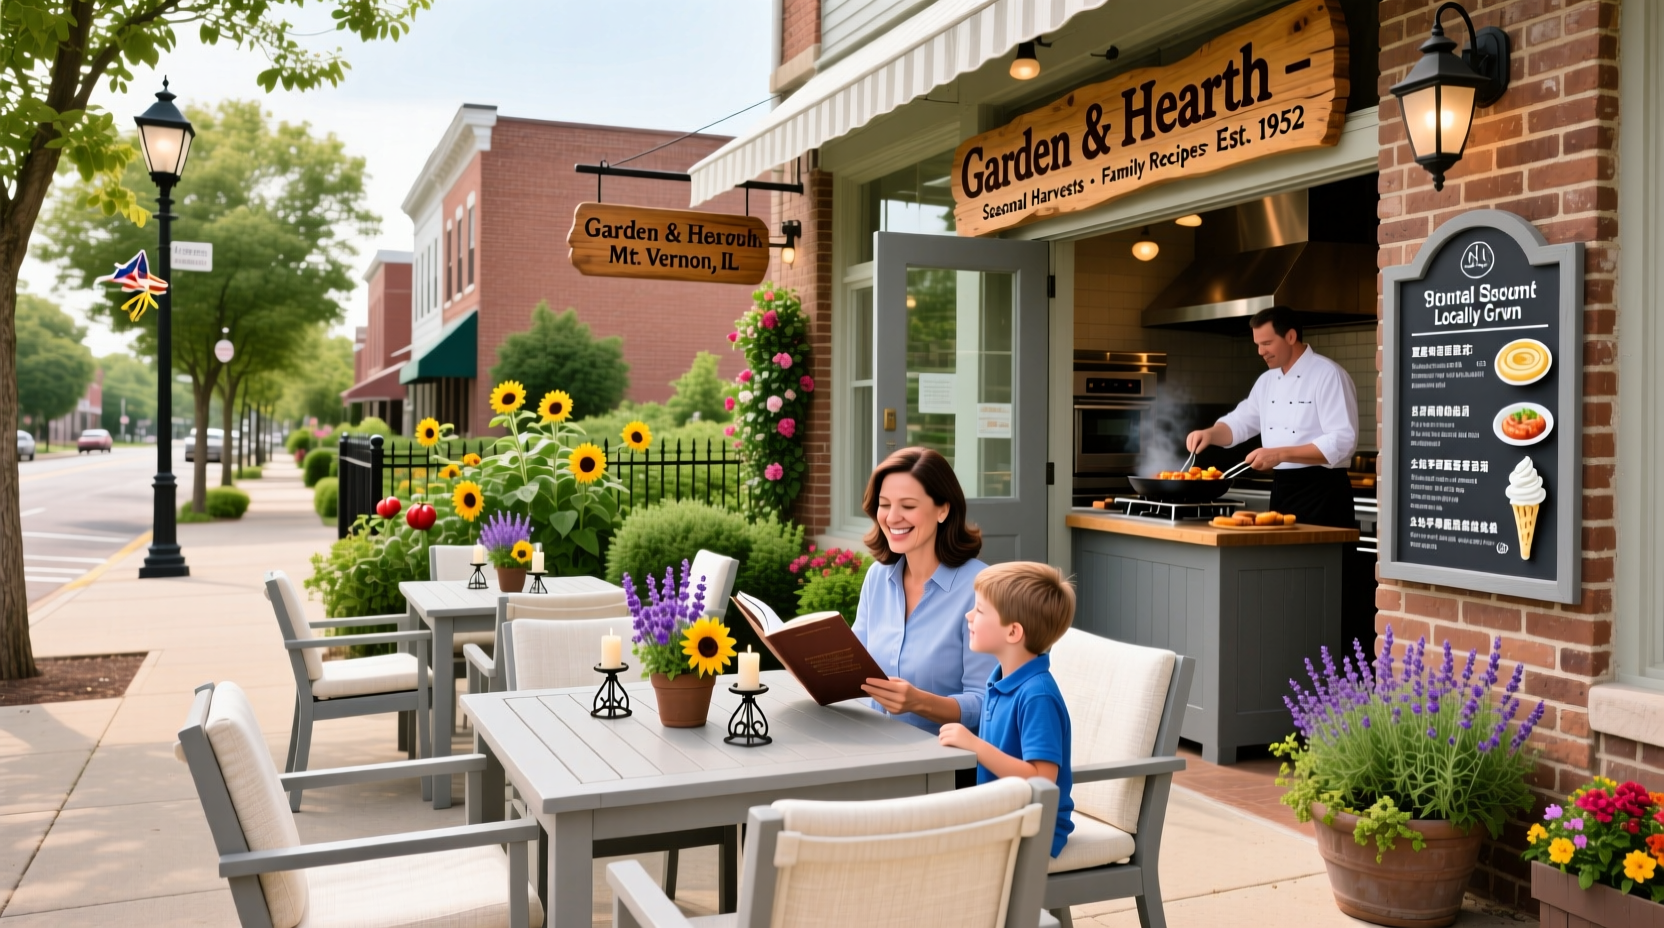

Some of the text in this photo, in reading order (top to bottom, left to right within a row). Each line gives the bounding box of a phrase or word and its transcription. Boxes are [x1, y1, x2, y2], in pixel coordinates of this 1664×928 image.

[961, 126, 1072, 199] Garden
[1082, 103, 1112, 160] &
[1121, 41, 1273, 148] Hearth
[1031, 178, 1085, 207] Harvests
[1102, 158, 1146, 185] Family
[1216, 125, 1252, 152] Est.
[1258, 105, 1305, 140] 1952
[584, 217, 659, 241] Garden
[665, 222, 682, 243] &
[609, 245, 740, 275] Mt. Vernon, IL
[1434, 306, 1481, 327] Locally
